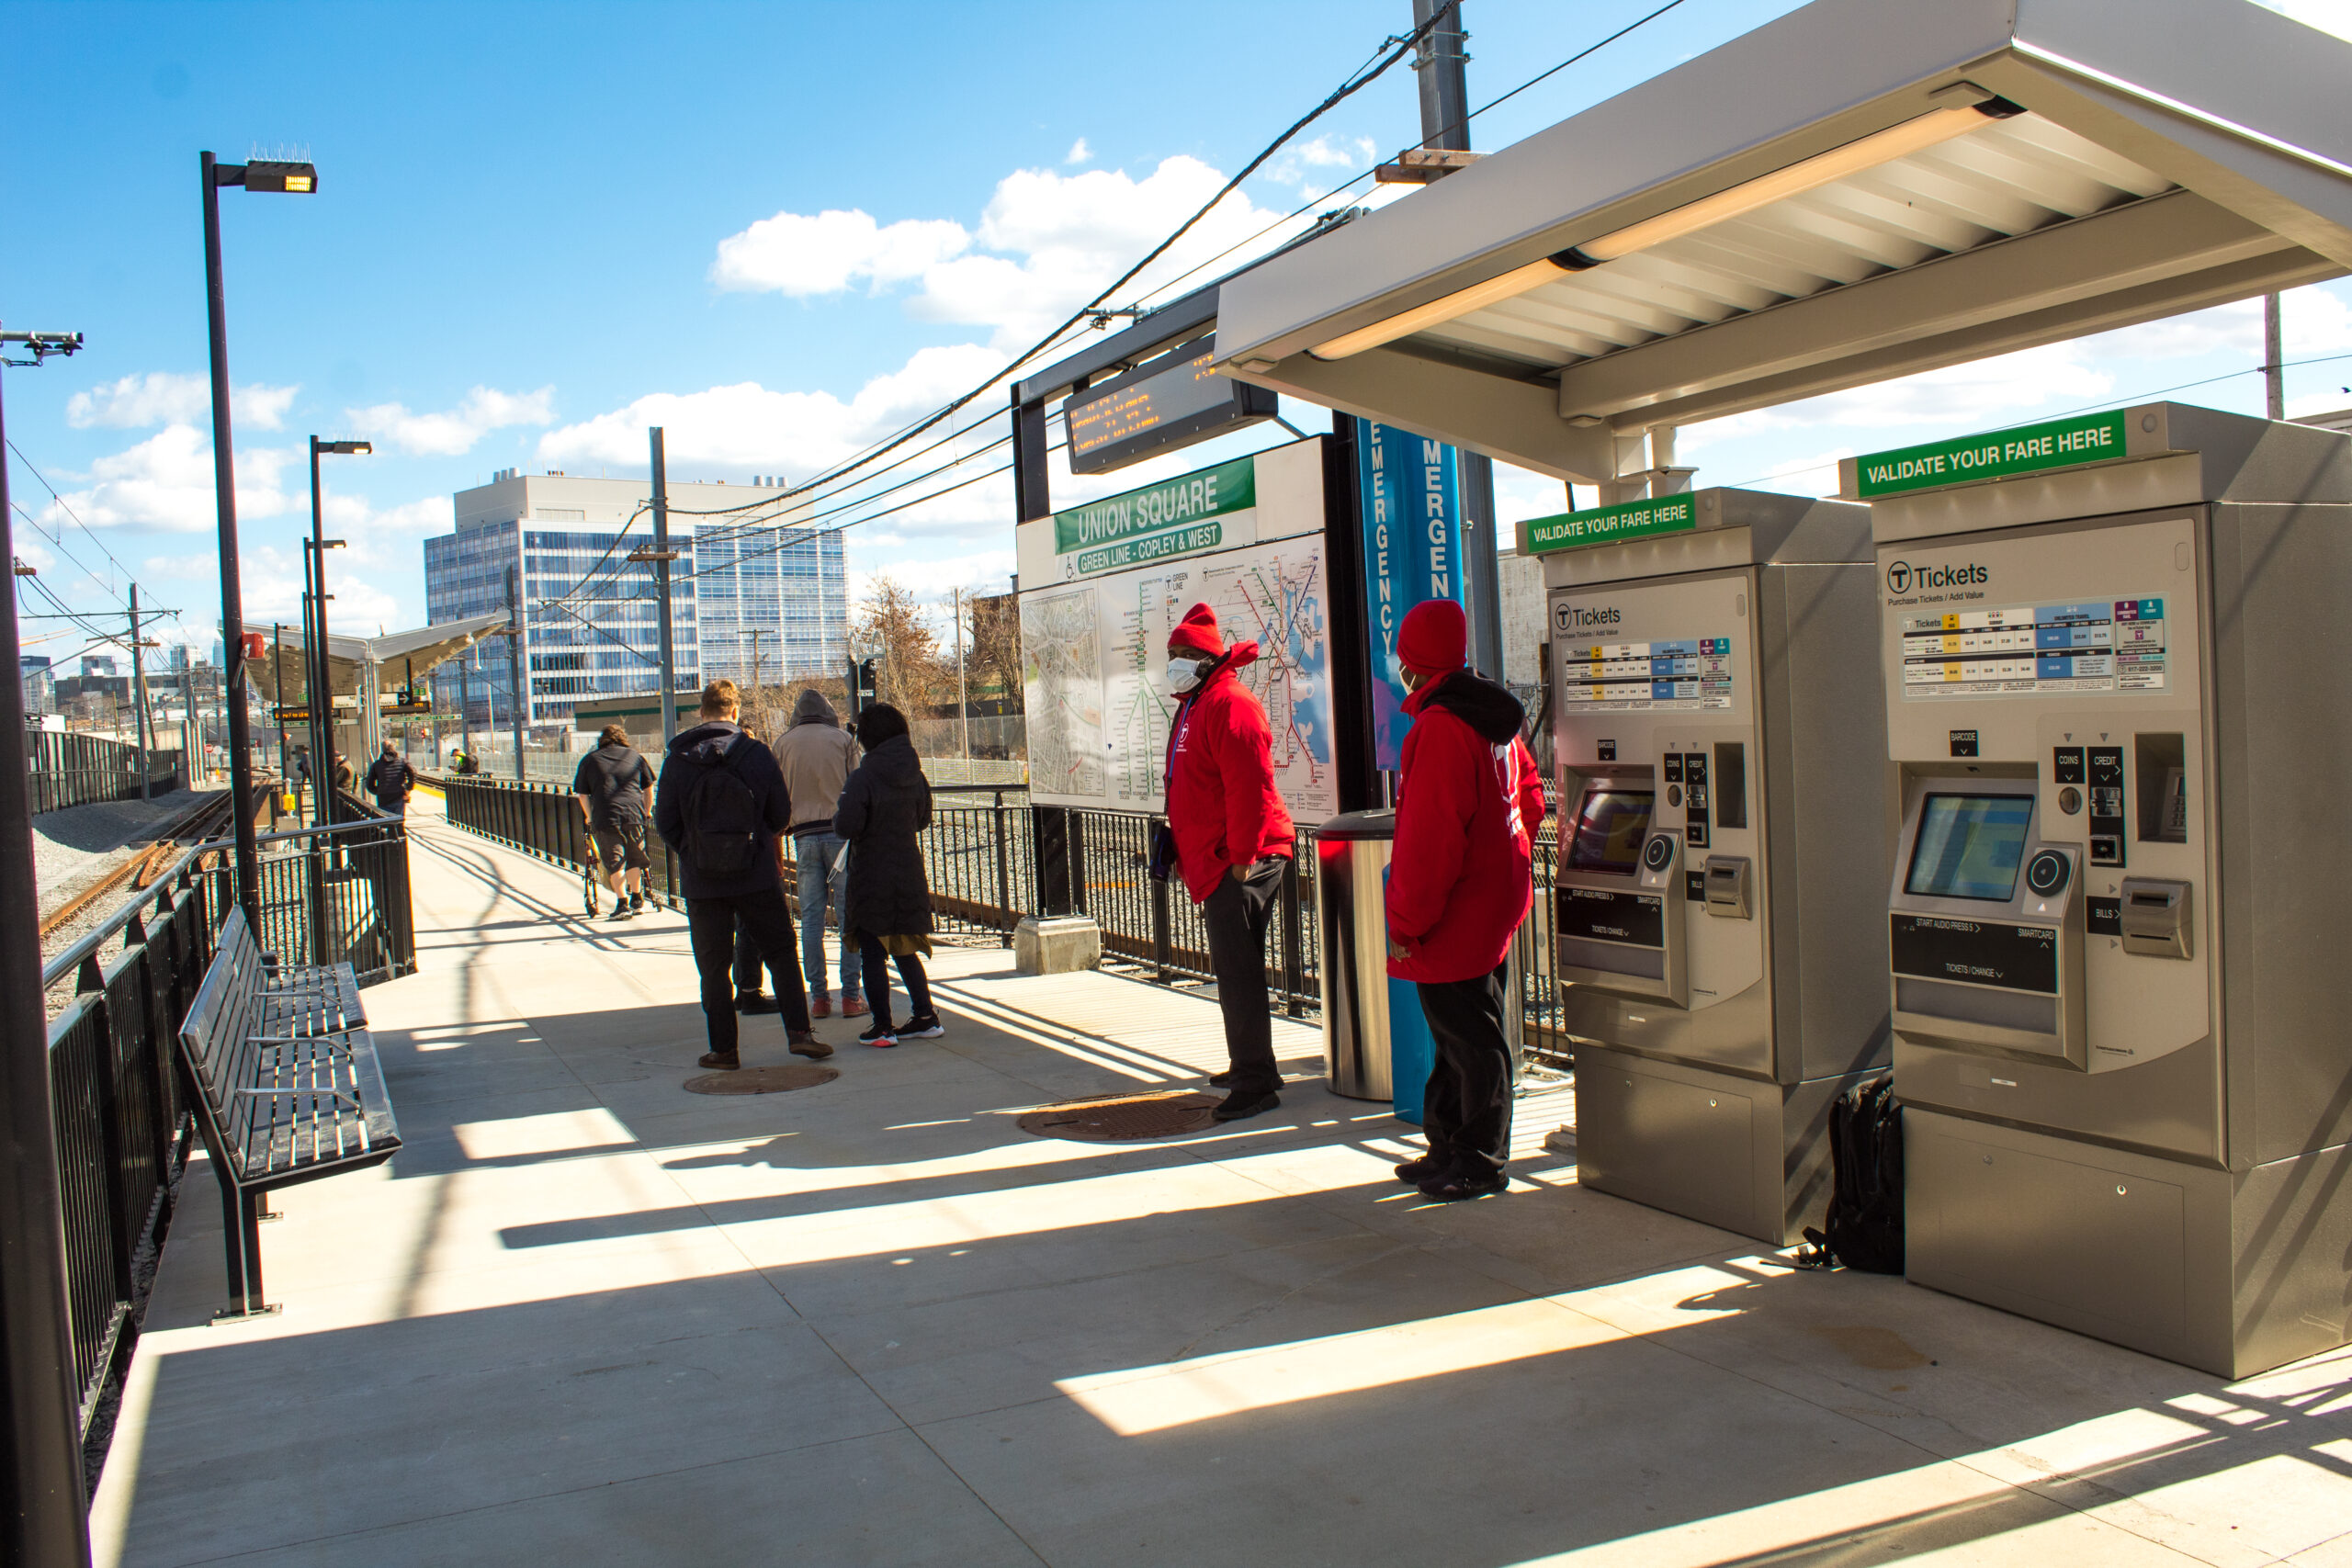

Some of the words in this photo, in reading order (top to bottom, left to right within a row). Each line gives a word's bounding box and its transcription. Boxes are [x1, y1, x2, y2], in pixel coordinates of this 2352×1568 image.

[1867, 455, 1945, 484] VALIDATE
[1949, 446, 2001, 471] YOUR
[2005, 436, 2052, 461] FARE
[2057, 425, 2112, 453] HERE
[1079, 501, 1131, 544] UNION
[1136, 475, 1218, 529] SQUARE
[1422, 440, 1449, 598] MERGEN
[1533, 522, 1584, 543] VALIDATE
[1585, 515, 1618, 533] YOUR
[1621, 510, 1651, 528] FARE
[1654, 504, 1688, 524] HERE
[1370, 421, 1393, 655] EMERGENCY
[1080, 549, 1109, 571] GREEN
[1111, 545, 1131, 566] LINE
[1138, 534, 1179, 559] COPLEY
[1179, 537, 1186, 550] &
[1187, 525, 1218, 548] WEST
[1173, 572, 1188, 582] GREEN
[1914, 563, 1988, 589] Tickets
[1888, 597, 1917, 606] Purchase
[1918, 594, 1944, 604] Tickets
[1949, 592, 1963, 601] Add
[1965, 591, 1984, 600] Value
[1572, 607, 1621, 626] Tickets
[1914, 619, 1941, 628] Tickets
[1951, 733, 1977, 741] BARCODE
[2058, 755, 2080, 765] COINS
[2094, 756, 2117, 766] CREDIT
[2096, 908, 2113, 919] BILLS
[1916, 919, 1933, 929] START
[1934, 920, 1950, 930] AUDIO
[1951, 922, 1969, 932] PRESS
[2017, 928, 2054, 940] SMARTCARD
[1946, 963, 1968, 974] TICKETS
[1971, 966, 1995, 977] CHANGE
